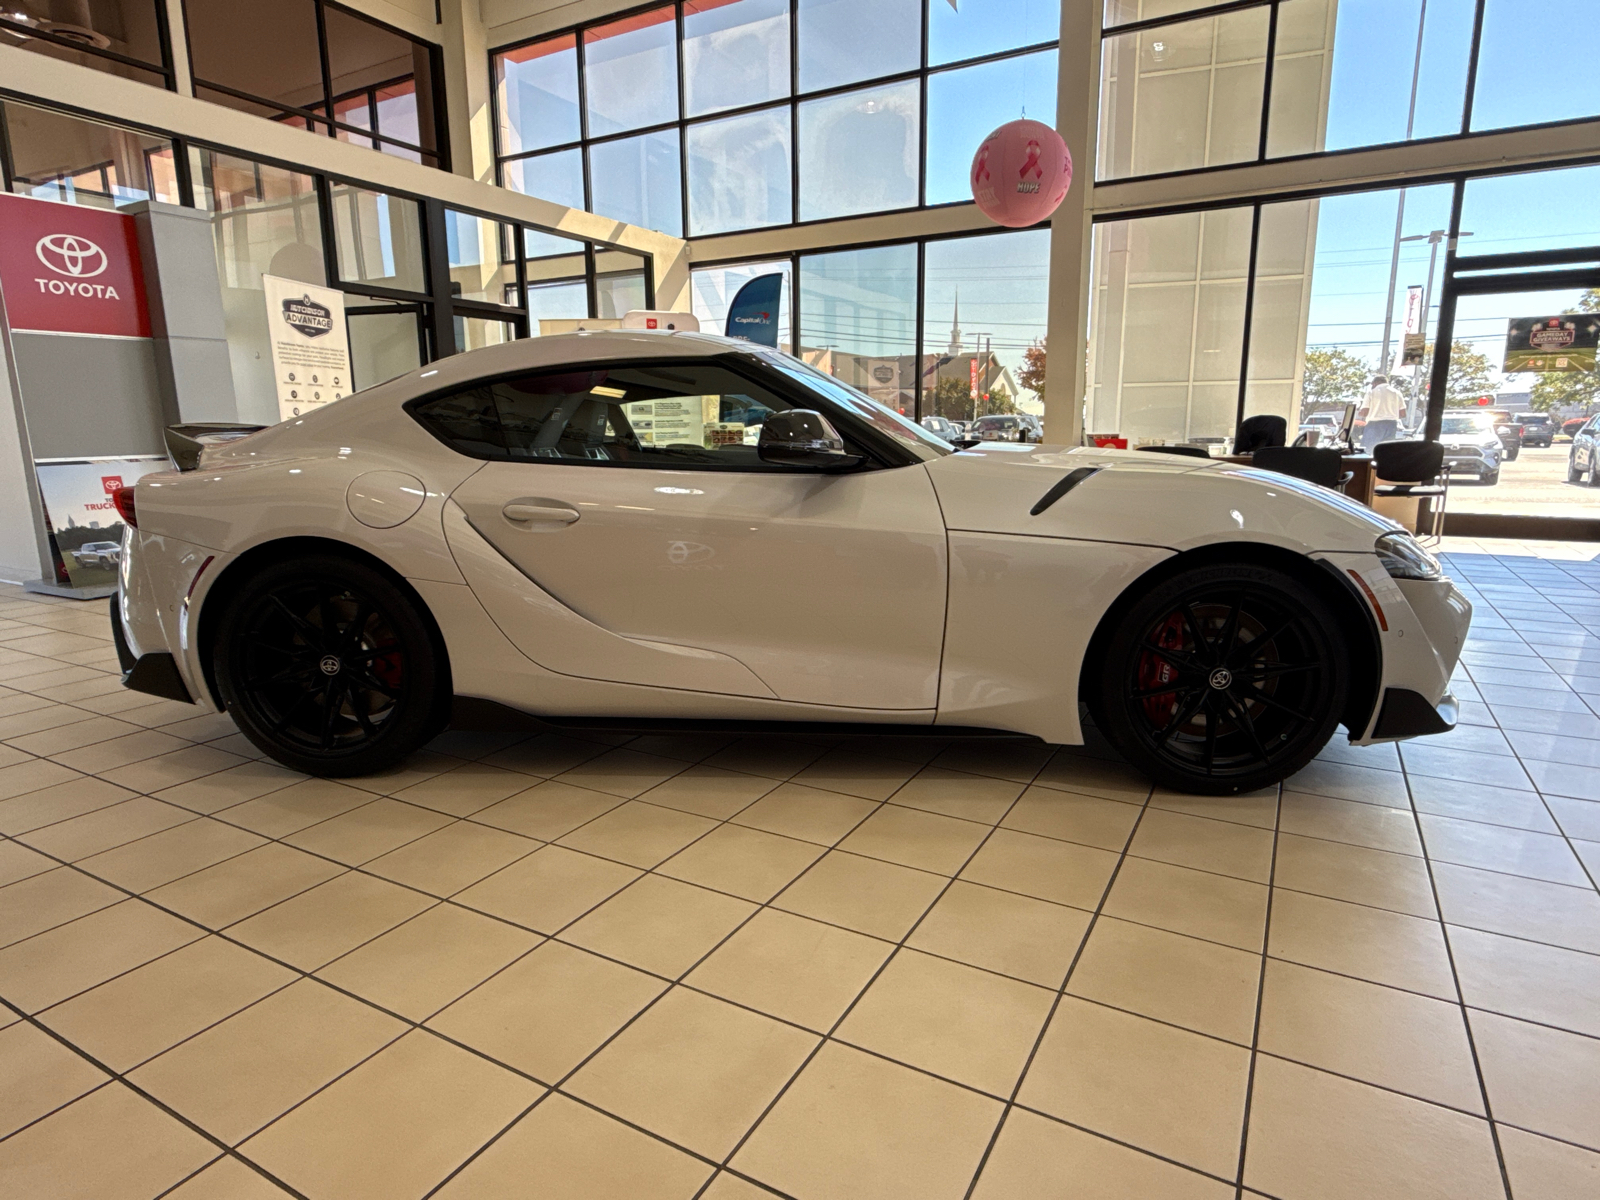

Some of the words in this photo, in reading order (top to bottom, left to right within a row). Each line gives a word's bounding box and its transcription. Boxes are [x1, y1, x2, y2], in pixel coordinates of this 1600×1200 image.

[1017, 182, 1041, 193] HOPE
[34, 278, 120, 300] TOYOTA
[286, 313, 331, 328] ADVANTAGE
[1162, 664, 1170, 682] GR
